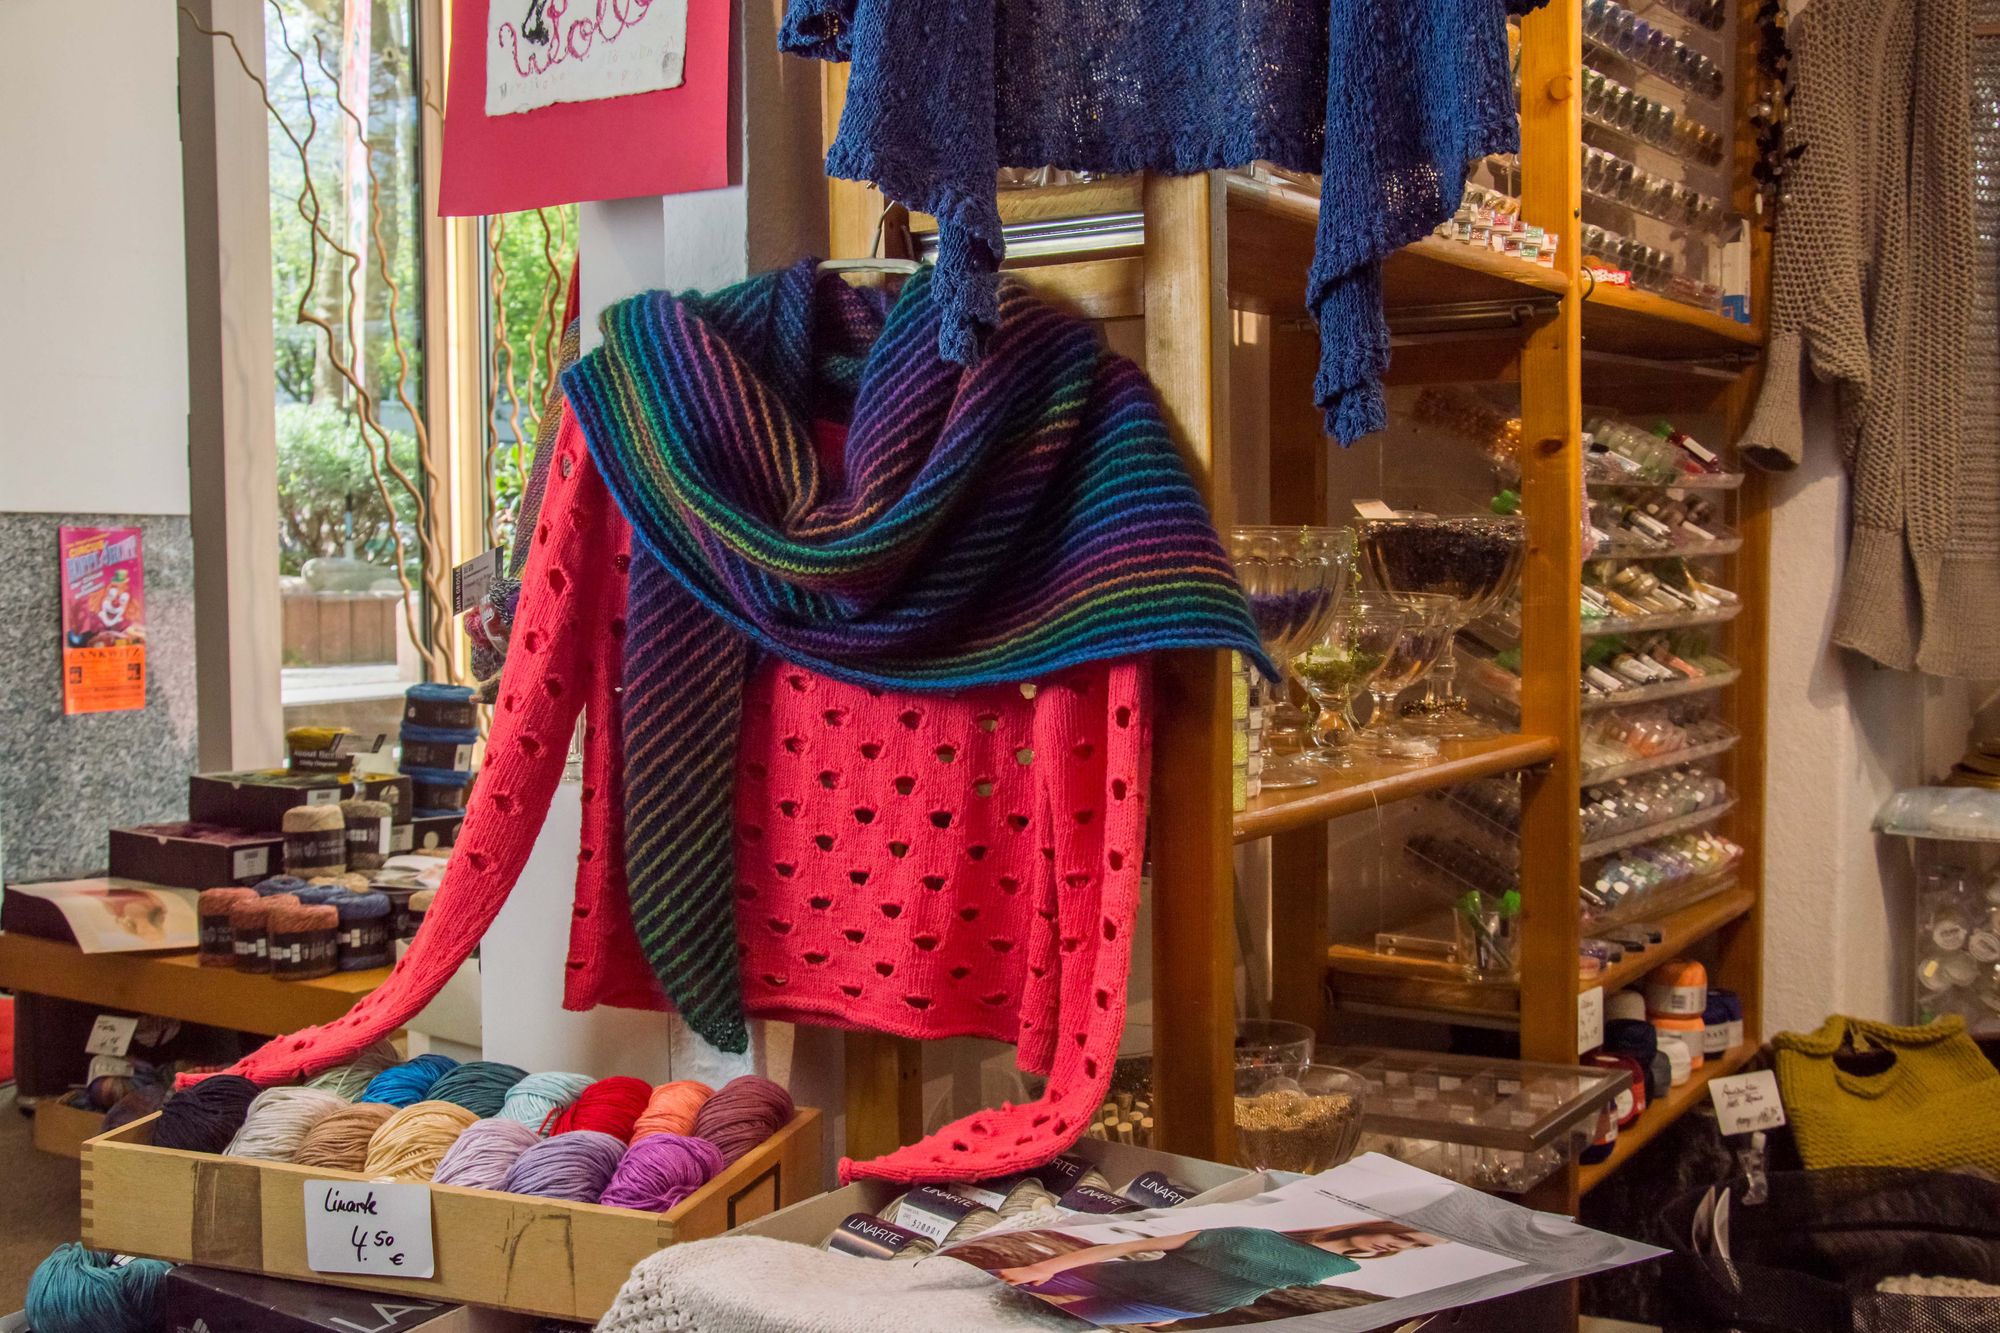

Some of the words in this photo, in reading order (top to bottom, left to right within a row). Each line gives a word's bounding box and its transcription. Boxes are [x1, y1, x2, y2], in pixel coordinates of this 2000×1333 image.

[921, 1186, 977, 1208] LINARTE
[1077, 1187, 1127, 1206] LINARTE
[847, 1218, 905, 1246] LINARTE
